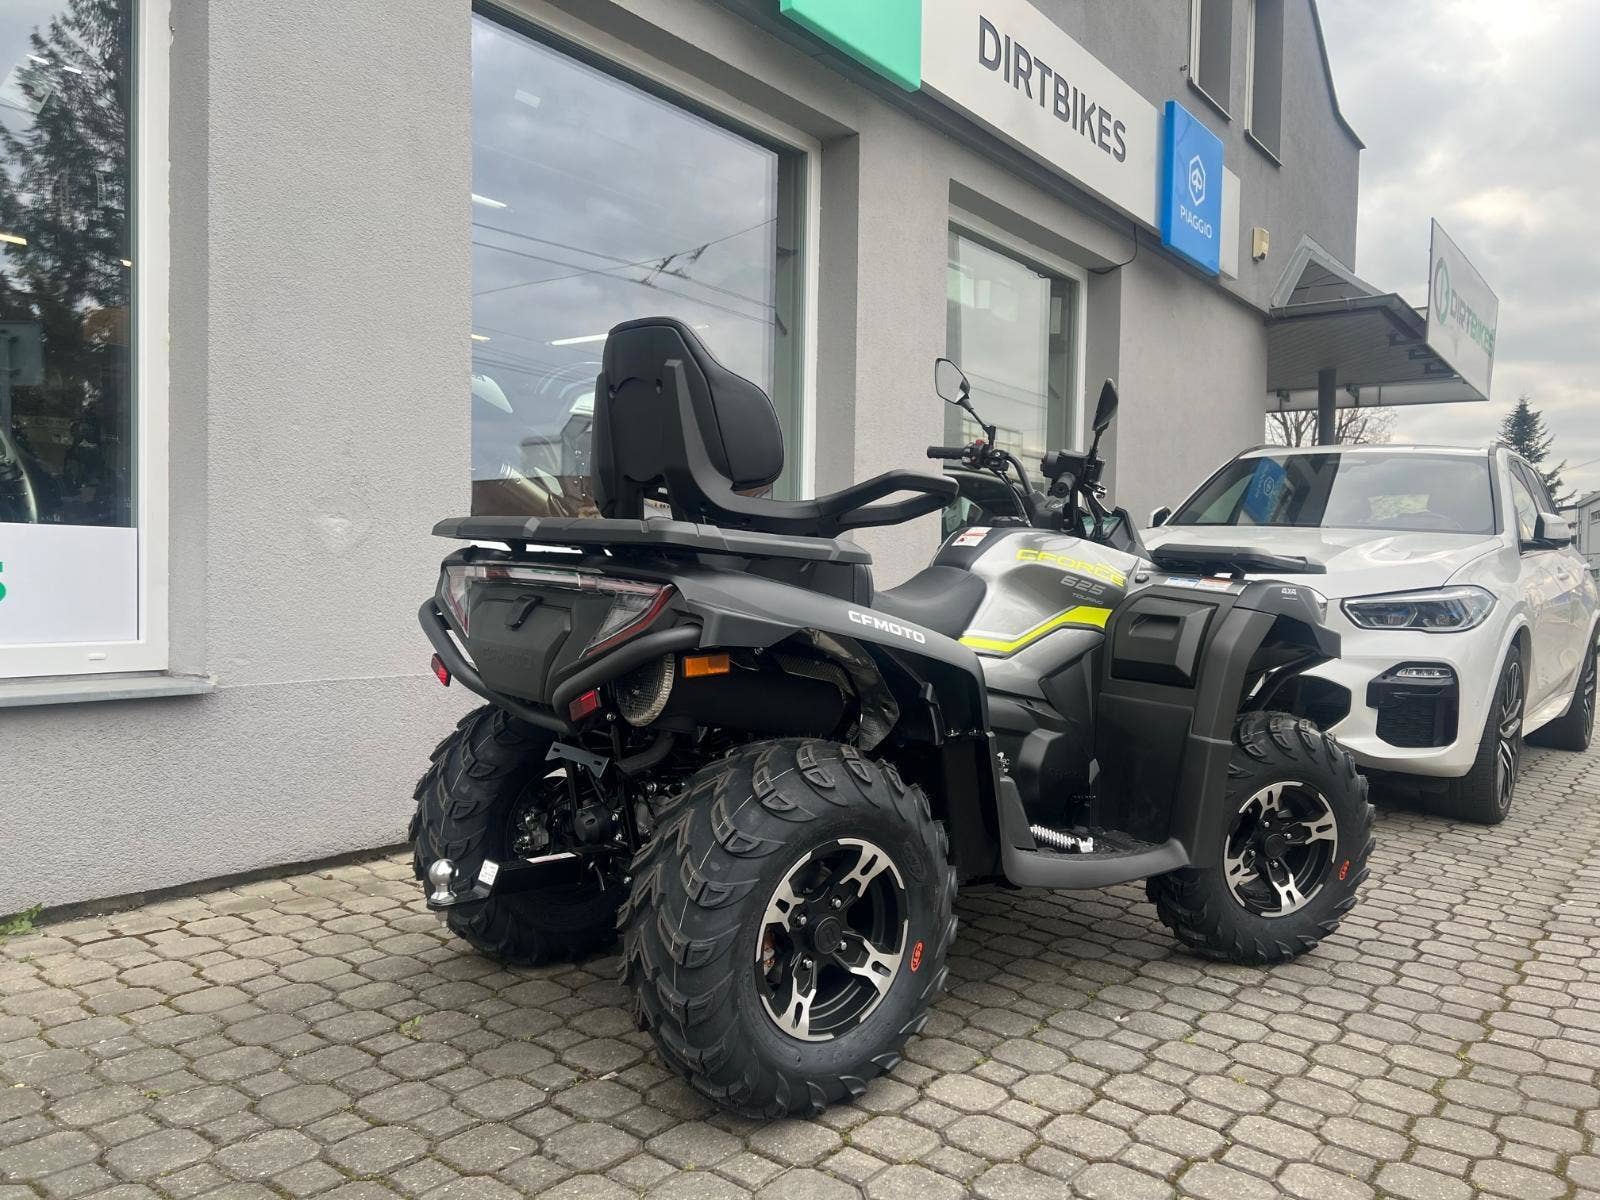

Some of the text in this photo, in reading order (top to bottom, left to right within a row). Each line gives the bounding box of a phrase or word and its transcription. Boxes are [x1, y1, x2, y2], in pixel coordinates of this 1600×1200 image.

[979, 15, 1126, 163] DIRTBIKES
[1180, 205, 1213, 239] PIAGGIO
[1017, 548, 1127, 587] CFORCE
[1060, 575, 1106, 595] 625
[848, 610, 926, 644] CFMOTO
